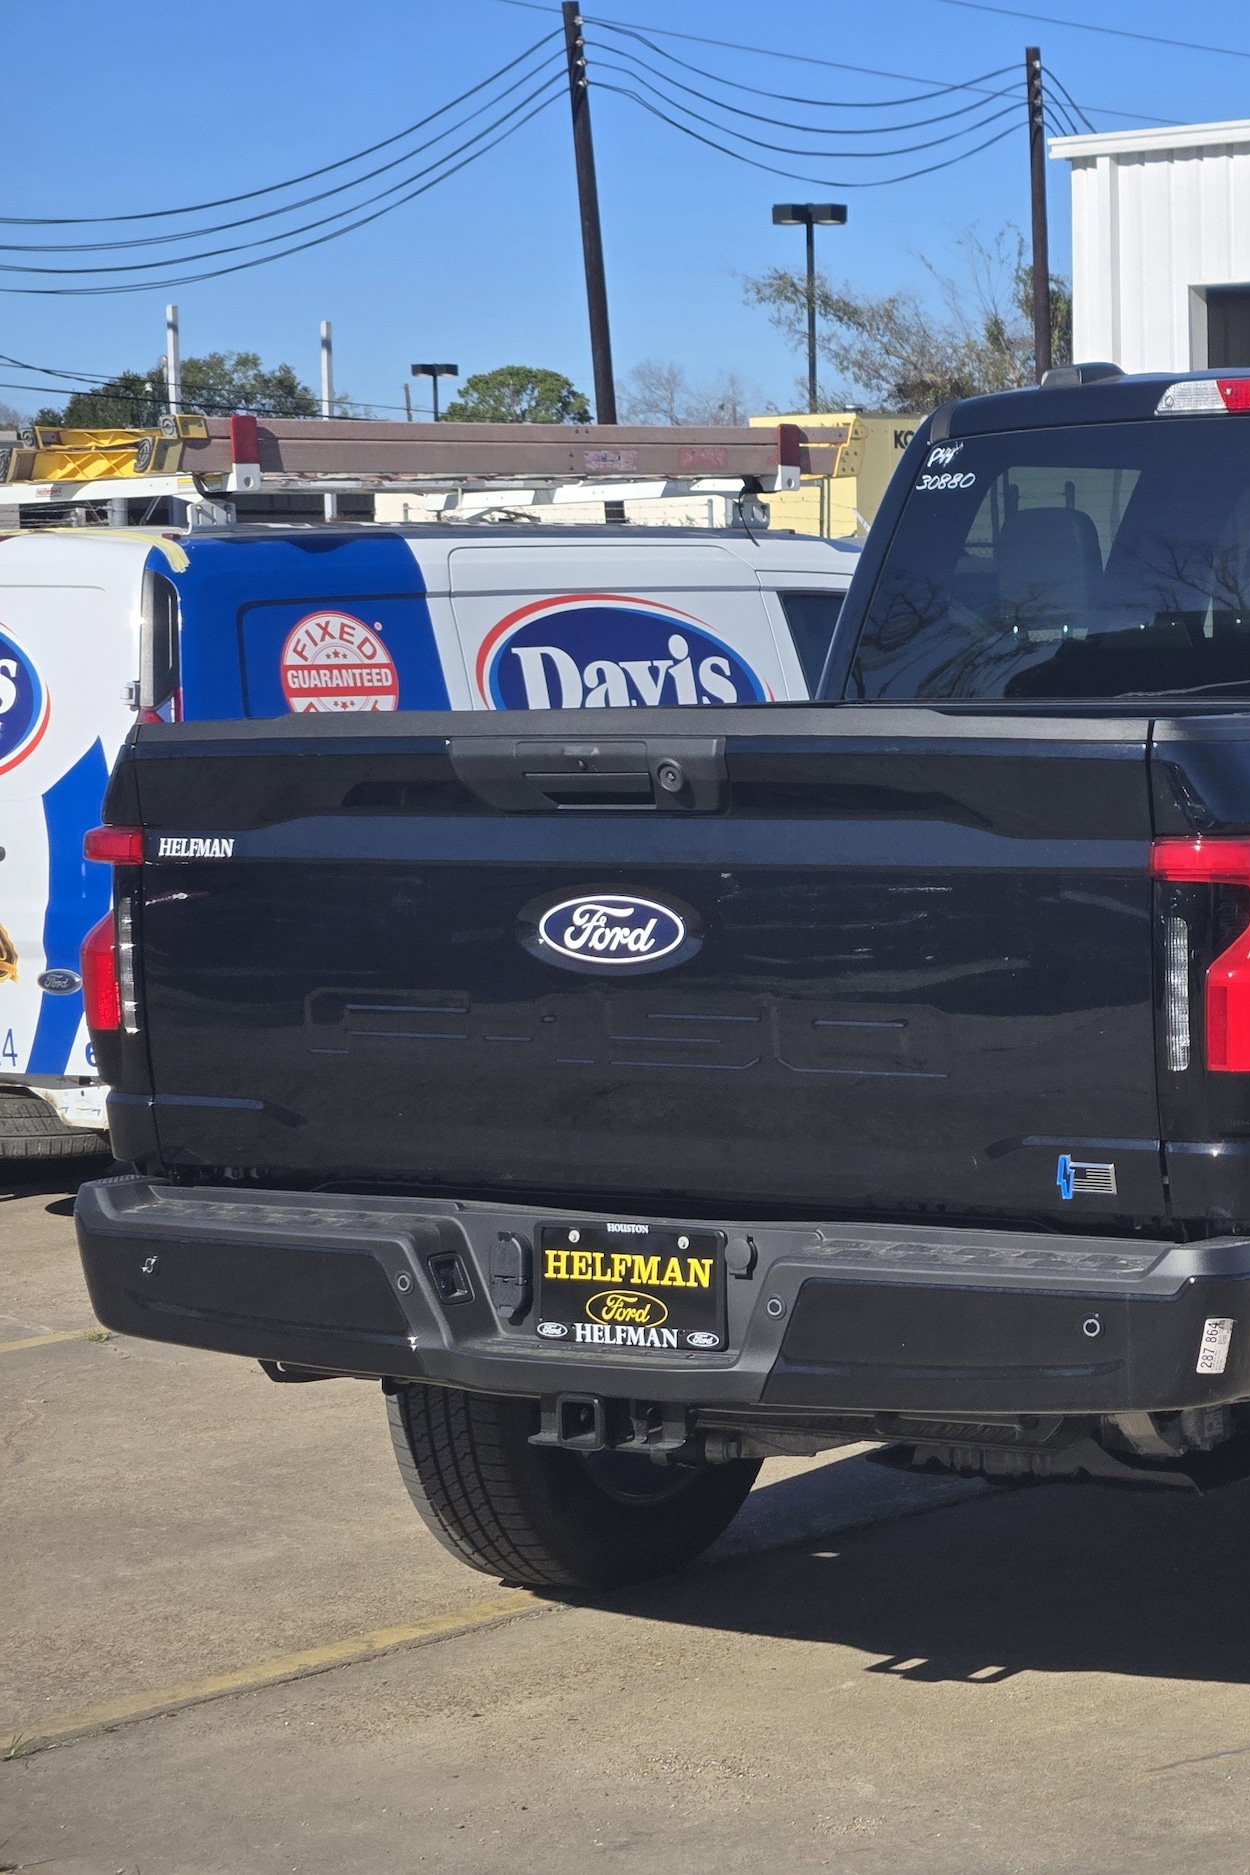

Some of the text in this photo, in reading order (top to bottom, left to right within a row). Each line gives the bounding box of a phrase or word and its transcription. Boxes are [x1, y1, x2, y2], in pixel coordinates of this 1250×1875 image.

[916, 472, 976, 490] 30880
[292, 620, 378, 662] FIXED
[287, 668, 393, 689] GUARANTEED
[511, 634, 738, 710] Davis
[158, 837, 235, 858] HELFMAN
[564, 904, 657, 952] Ford
[606, 1222, 650, 1234] HOUSTON
[544, 1250, 714, 1288] HELFMAN
[602, 1294, 652, 1323] Ford
[573, 1322, 679, 1349] HELFMAN
[1200, 1348, 1215, 1368] 287
